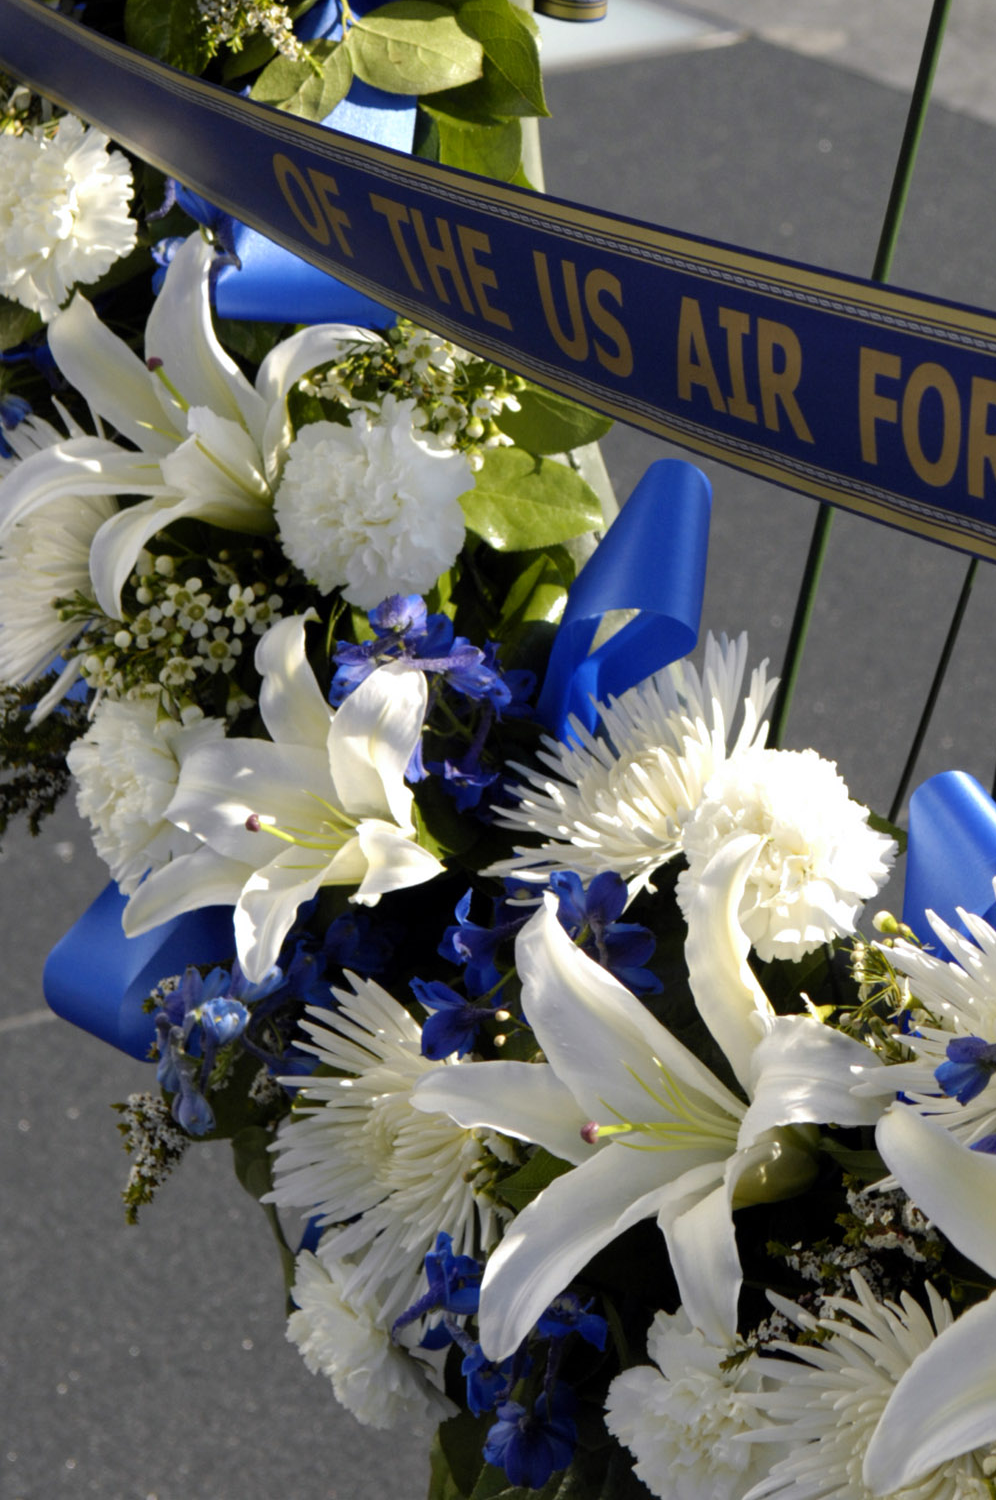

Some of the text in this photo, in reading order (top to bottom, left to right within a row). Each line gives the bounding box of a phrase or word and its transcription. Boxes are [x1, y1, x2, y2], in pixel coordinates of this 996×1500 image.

[272, 152, 355, 259] OF
[368, 192, 513, 332] THE
[532, 250, 634, 378] US
[676, 296, 816, 445] AIR
